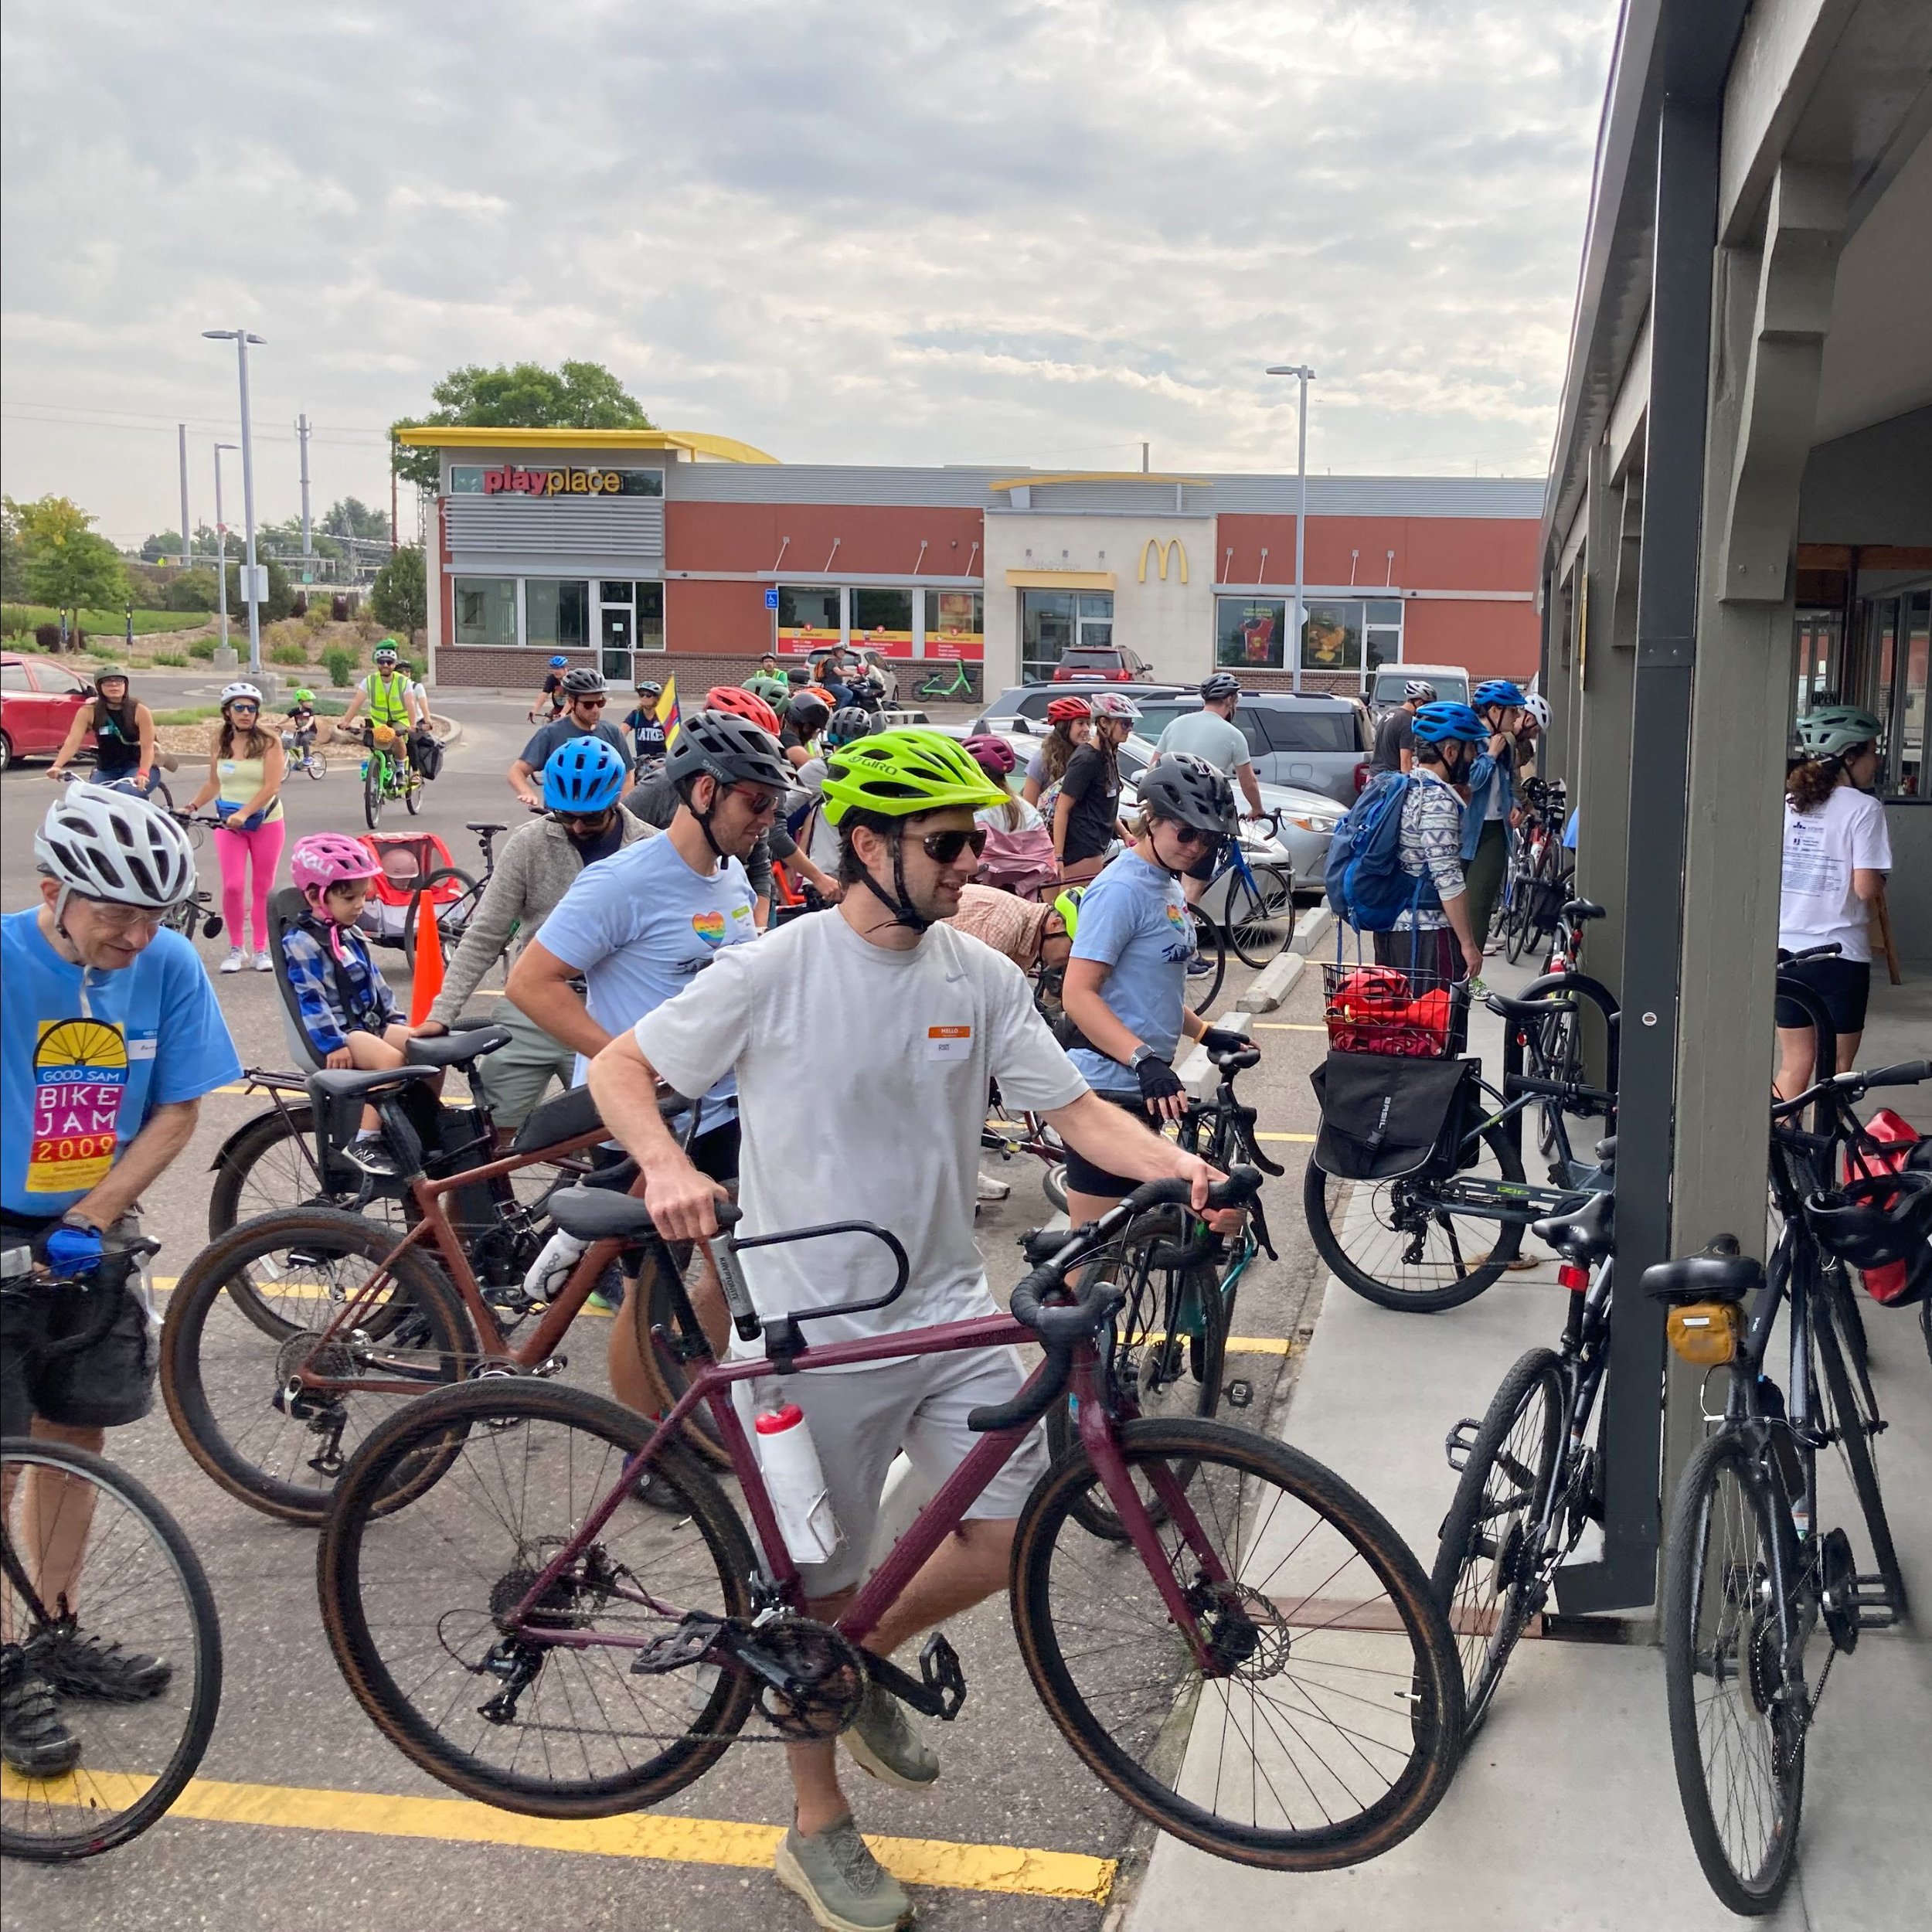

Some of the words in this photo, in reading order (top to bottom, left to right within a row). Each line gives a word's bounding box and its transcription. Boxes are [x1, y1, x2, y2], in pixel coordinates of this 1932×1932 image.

[484, 464, 621, 496] playplace
[1811, 692, 1836, 704] OPEN
[702, 759, 723, 779] SMITH
[862, 758, 897, 775] GIRO
[43, 1070, 83, 1082] GOOD
[87, 1072, 120, 1083] SAM
[39, 1087, 120, 1109] BIKE
[36, 1111, 117, 1136] JAM
[1379, 1097, 1392, 1129] BASIL
[38, 1137, 114, 1162] 2009
